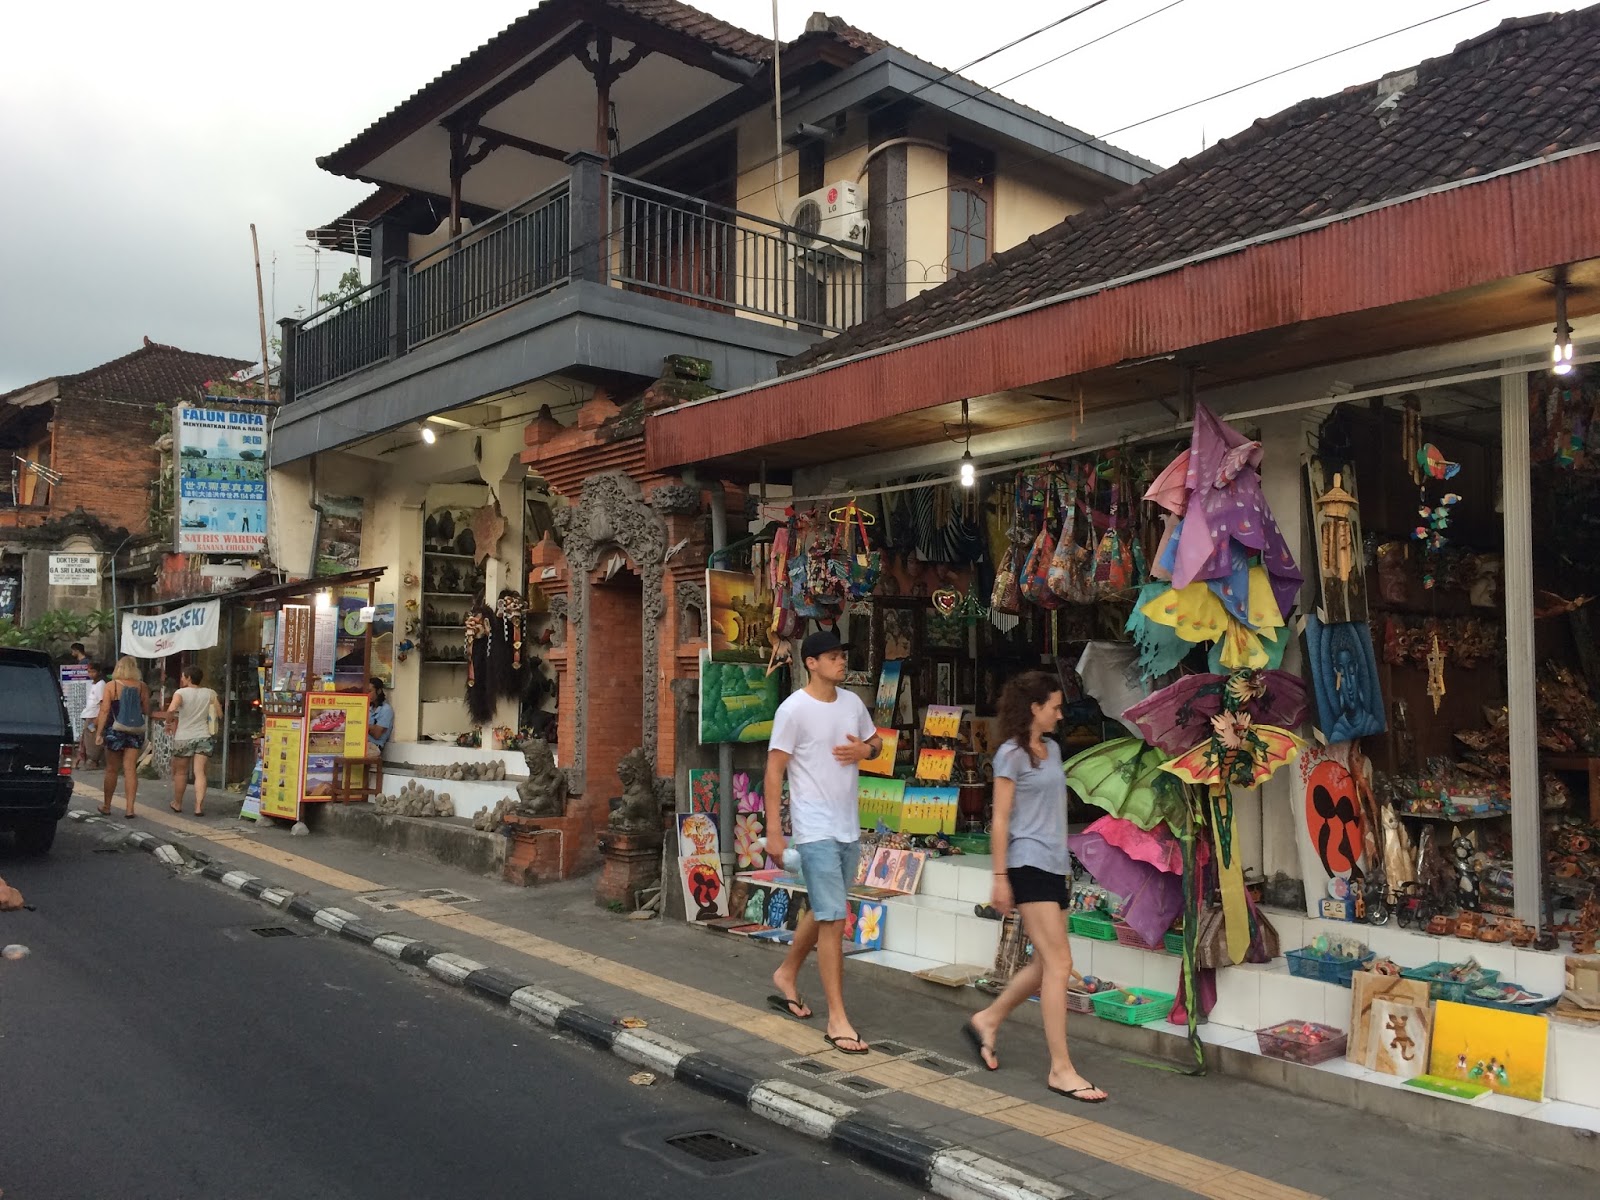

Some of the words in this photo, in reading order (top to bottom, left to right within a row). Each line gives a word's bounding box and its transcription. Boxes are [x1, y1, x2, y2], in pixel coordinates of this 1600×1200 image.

[829, 205, 837, 213] LG
[182, 408, 226, 423] FALUN
[229, 413, 264, 426] DAFA
[183, 421, 226, 430] MENYEHATKAN
[222, 534, 264, 545] WARUNG
[196, 543, 224, 551] BANANA
[131, 619, 158, 637] PURI
[160, 607, 206, 636] REJEKI
